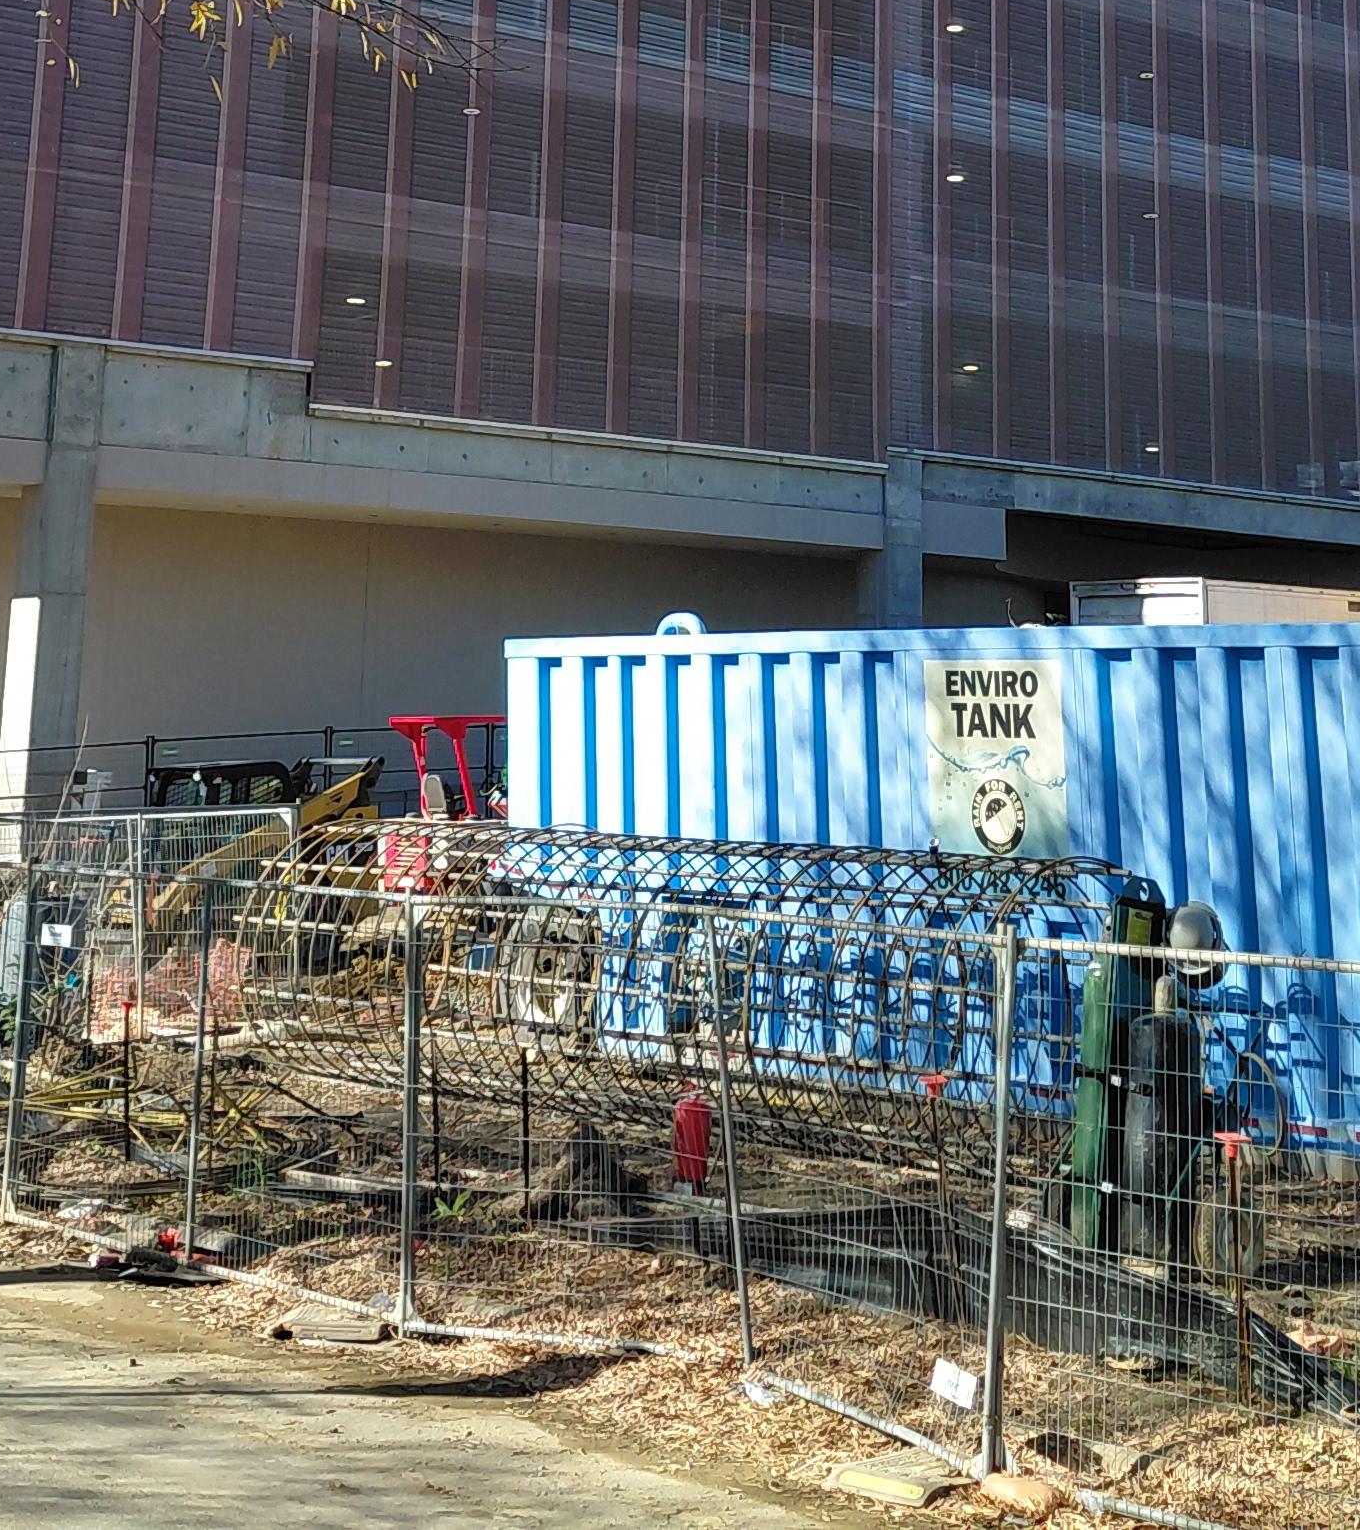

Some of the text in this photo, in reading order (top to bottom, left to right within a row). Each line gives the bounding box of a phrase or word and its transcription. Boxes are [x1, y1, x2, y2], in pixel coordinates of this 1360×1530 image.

[945, 669, 1039, 698] ENVIRO
[950, 702, 1036, 739] TANK
[973, 780, 1025, 831] RAIN FOR RENT
